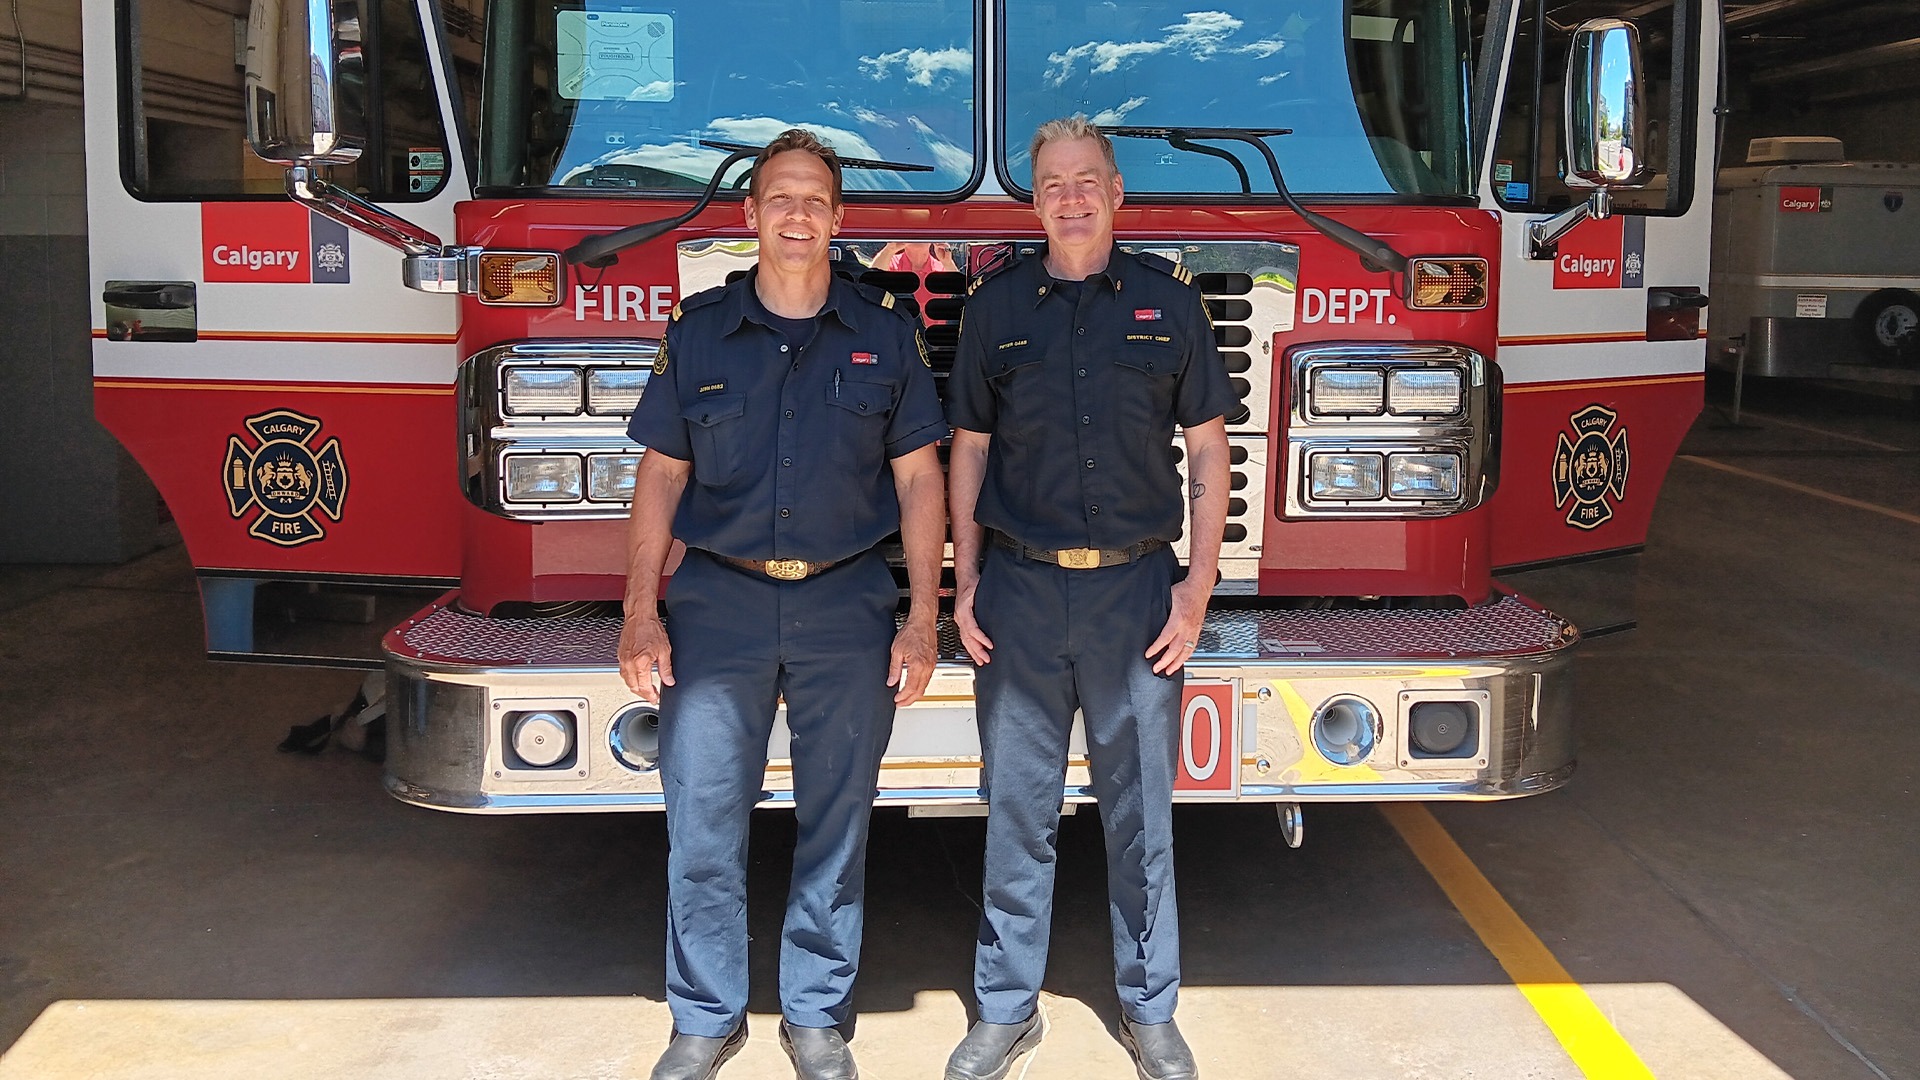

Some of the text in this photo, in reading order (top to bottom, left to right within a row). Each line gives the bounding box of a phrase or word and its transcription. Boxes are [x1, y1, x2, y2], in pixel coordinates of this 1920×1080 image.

[1783, 200, 1815, 210] Calgary
[212, 245, 299, 270] Calgary
[1560, 254, 1616, 278] Calgary
[575, 285, 672, 321] FIRE
[1302, 288, 1396, 325] DEPT.
[263, 424, 305, 436] CALGARY
[1581, 417, 1607, 428] CALGARY
[1580, 506, 1599, 520] FIRE
[271, 521, 302, 534] FIRE
[1182, 693, 1221, 781] 0
